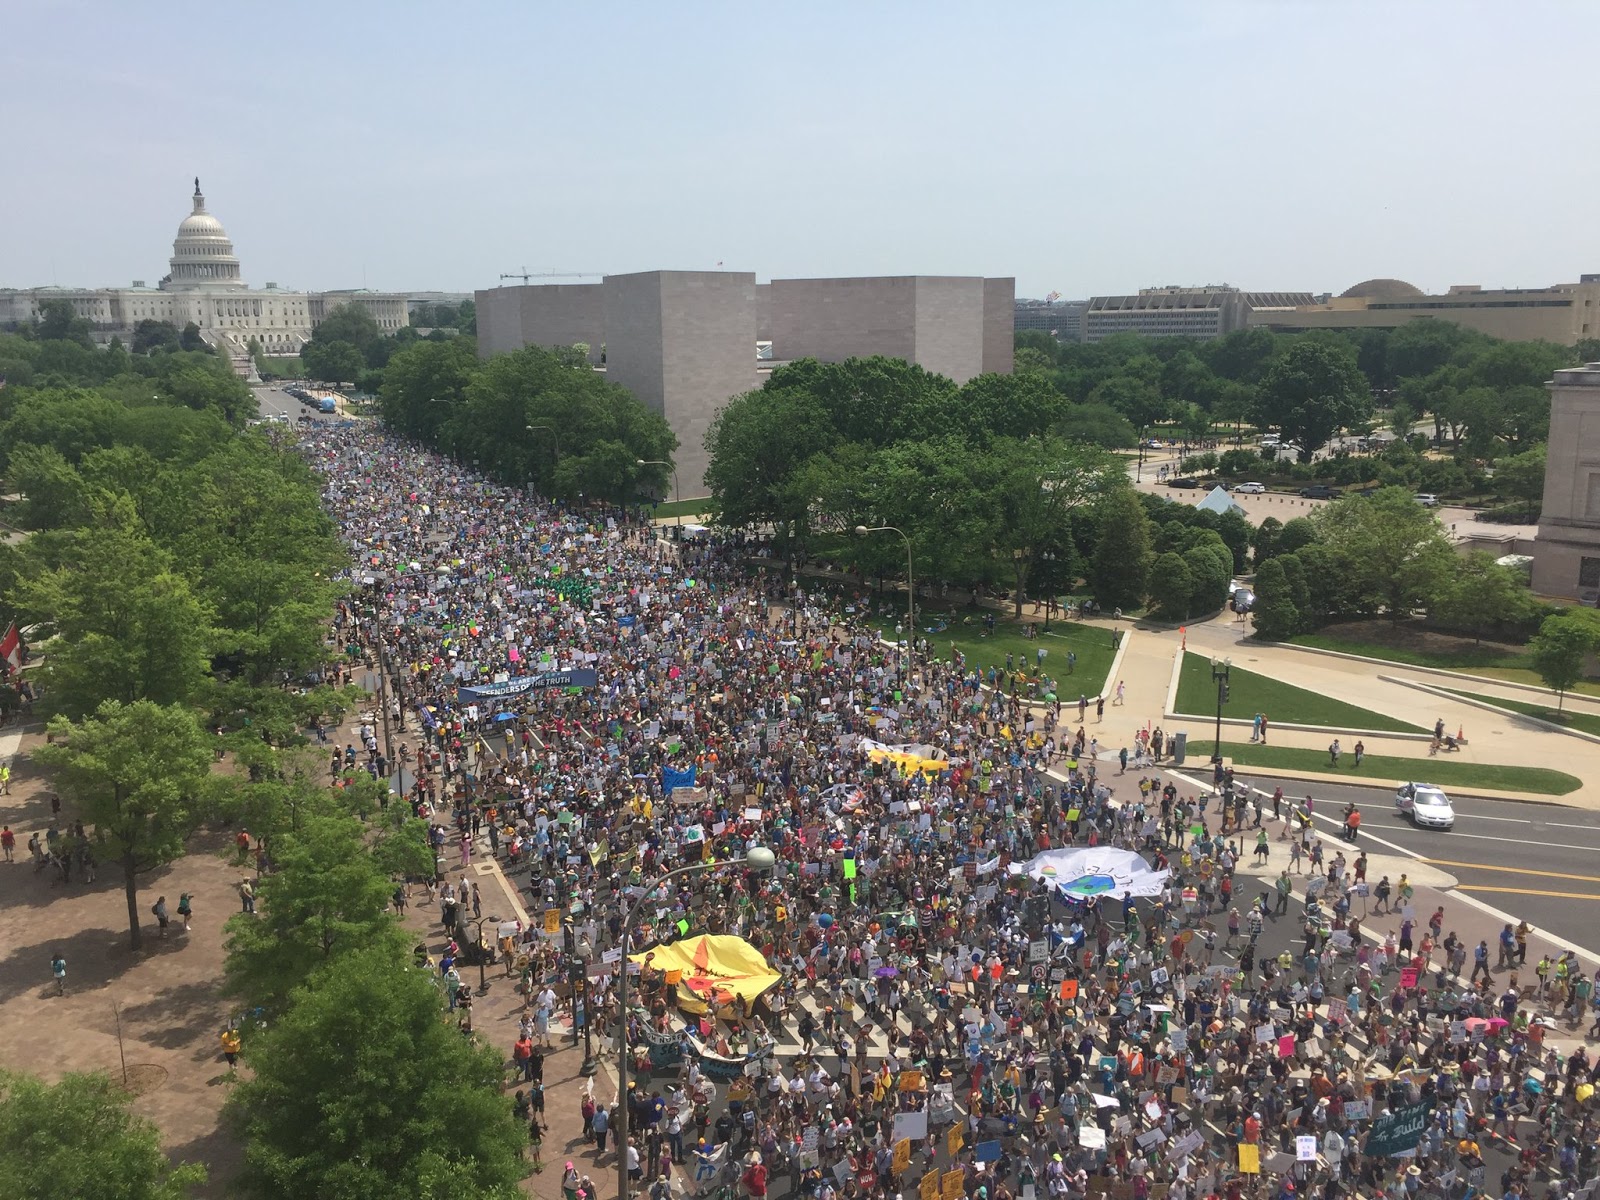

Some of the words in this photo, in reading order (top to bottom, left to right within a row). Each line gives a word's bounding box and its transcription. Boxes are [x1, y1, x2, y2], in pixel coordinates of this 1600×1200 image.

[476, 685, 520, 696] DEFENDERS
[531, 679, 545, 688] THE
[546, 676, 571, 686] TRUTH
[1391, 1115, 1425, 1139] Build
[860, 1173, 873, 1184] NOW
